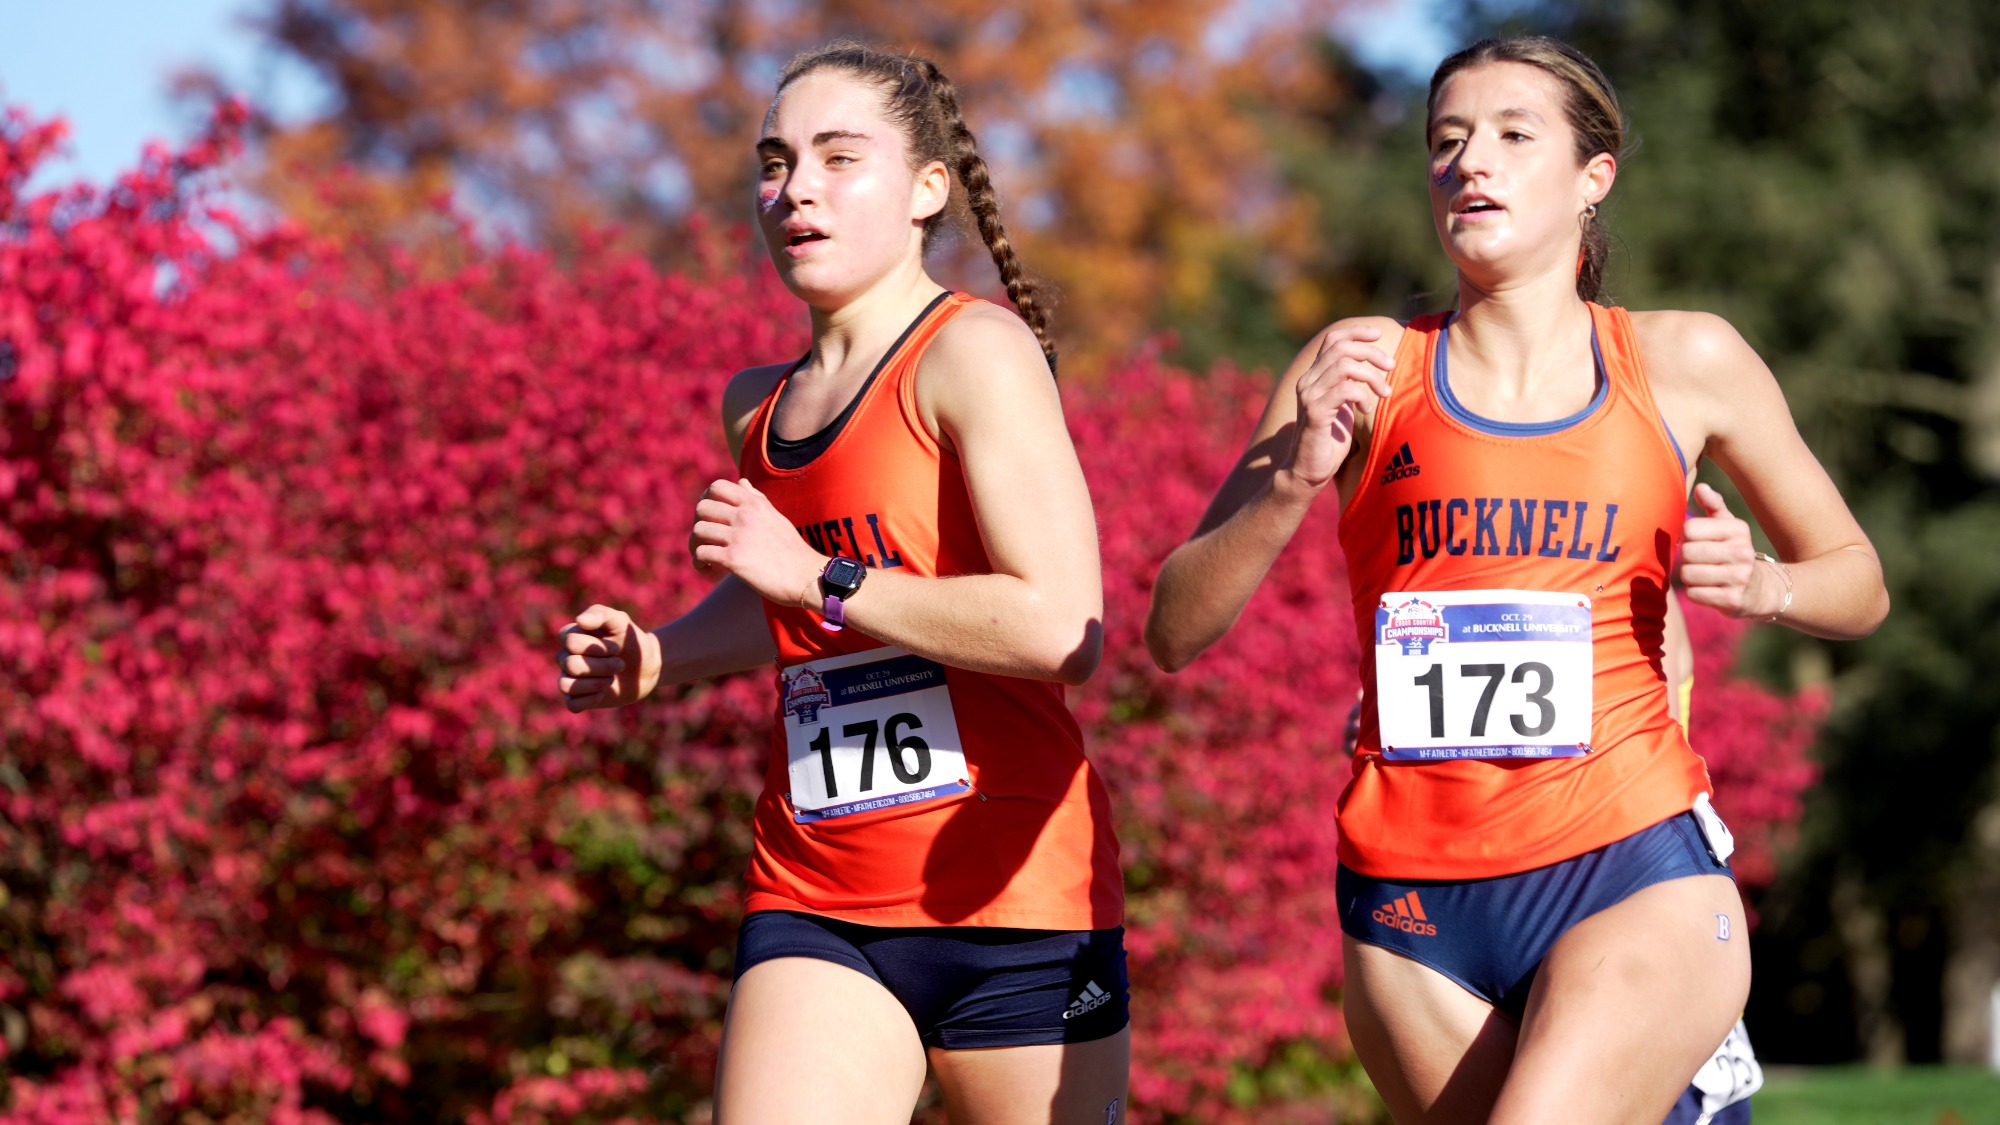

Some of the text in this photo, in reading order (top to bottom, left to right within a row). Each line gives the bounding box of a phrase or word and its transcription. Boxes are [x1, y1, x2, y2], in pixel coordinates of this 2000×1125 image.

[1380, 464, 1420, 485] adidas
[797, 514, 903, 569] NELL
[1396, 498, 1621, 566] BUCKNELL
[1462, 623, 1580, 633] at BUCKNELL UNIVERSITY
[1501, 613, 1533, 621] OCT. 29
[1387, 626, 1444, 638] CHAMPIONSHIPS
[841, 670, 934, 696] at BUCKNELL UNIVERSITY
[865, 670, 891, 680] OCT. 29
[1414, 661, 1556, 738] 173
[809, 712, 931, 799] 176
[1432, 749, 1457, 758] ATHLETIC
[830, 805, 851, 816] ATHLETIC
[1372, 910, 1437, 936] adidas
[1715, 913, 1730, 941] B
[1062, 991, 1112, 1020] adidas
